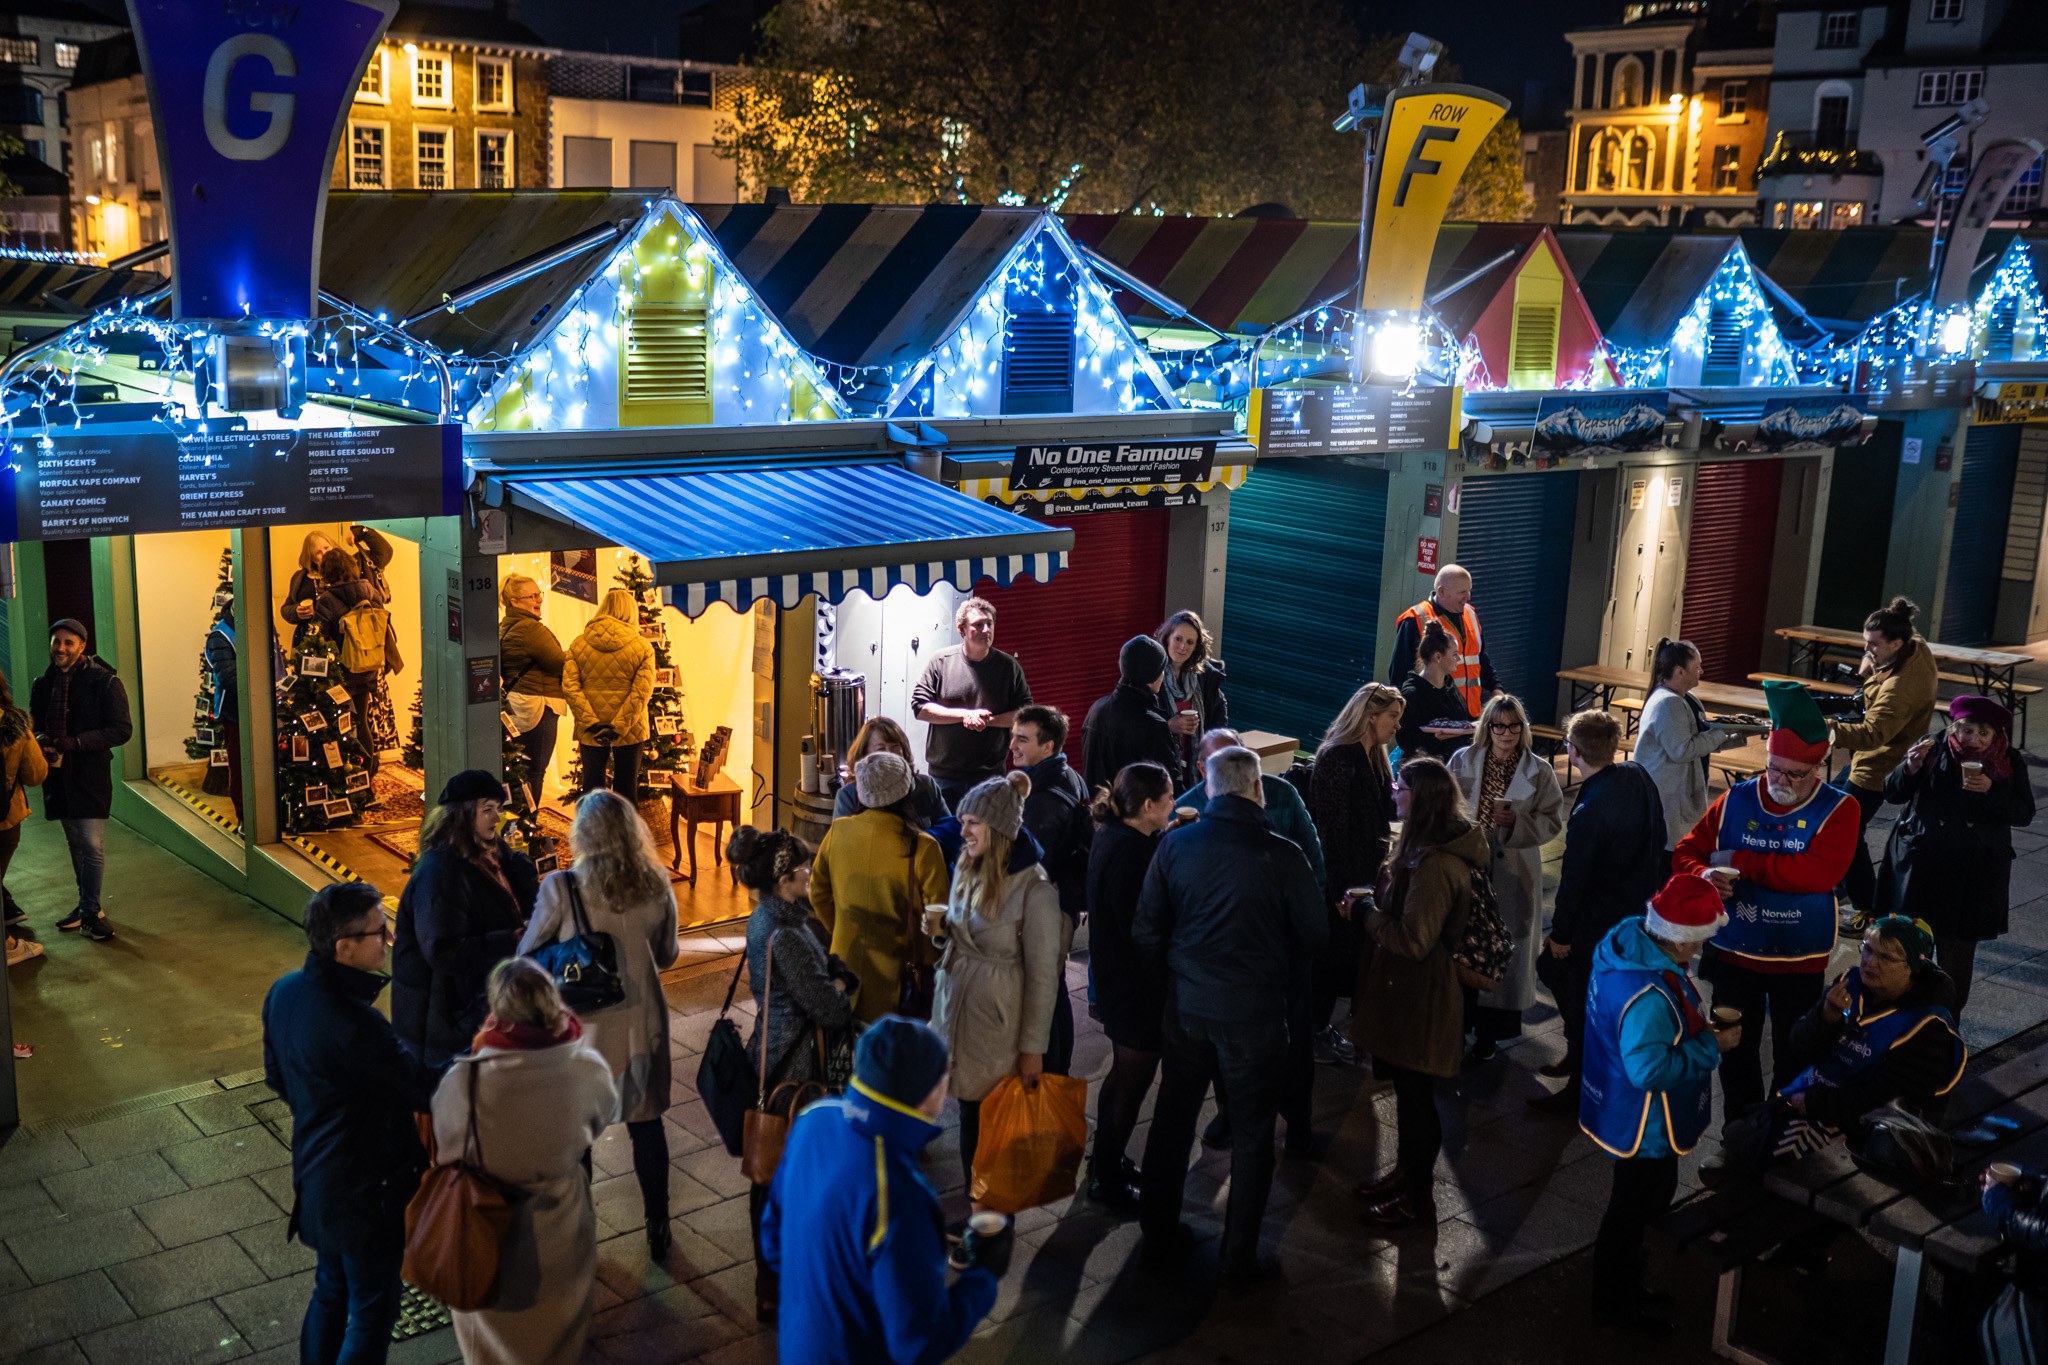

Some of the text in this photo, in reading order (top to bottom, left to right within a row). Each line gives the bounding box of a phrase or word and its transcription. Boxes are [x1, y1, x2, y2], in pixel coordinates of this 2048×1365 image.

[203, 33, 299, 161] G
[1429, 103, 1468, 123] ROW
[1393, 125, 1460, 207] F
[177, 433, 291, 444] NORWICH ELECTRICAL STORES
[323, 430, 380, 438] HABERDASHERY
[56, 449, 77, 457] games
[308, 449, 336, 457] MOBILE
[337, 448, 356, 456] GEEK
[357, 447, 380, 455] SQUAD
[1029, 445, 1203, 466] No One Famous
[38, 459, 97, 468] SIXTH SCENTS
[1050, 465, 1101, 475] Contemporary
[1101, 464, 1139, 472] Streetwear
[1153, 462, 1180, 470] Fashion
[1423, 461, 1437, 472] 118
[1455, 463, 1466, 472] 118
[39, 476, 141, 488] NORFOLK VAPE COMPANY
[179, 472, 217, 481] HARVEY'S
[1072, 476, 1151, 485] @no_one_famous_team
[180, 490, 244, 500] ORIENT EXPRESS
[309, 485, 346, 494] CITY HATS
[40, 498, 107, 508] CANARY COMICS
[1055, 500, 1149, 512] @no_one_famous_team
[181, 506, 287, 519] THE YARN AND CRAFT STORE
[41, 518, 78, 528] BARRY'S
[91, 516, 130, 524] NORWICH
[1211, 522, 1225, 532] 137
[1417, 562, 1436, 570] PIGEONS
[468, 577, 492, 591] 138
[1741, 833, 1766, 848] Here
[1768, 838, 1780, 849] to
[1761, 908, 1802, 919] Norwich
[1848, 1040, 1872, 1059] Help
